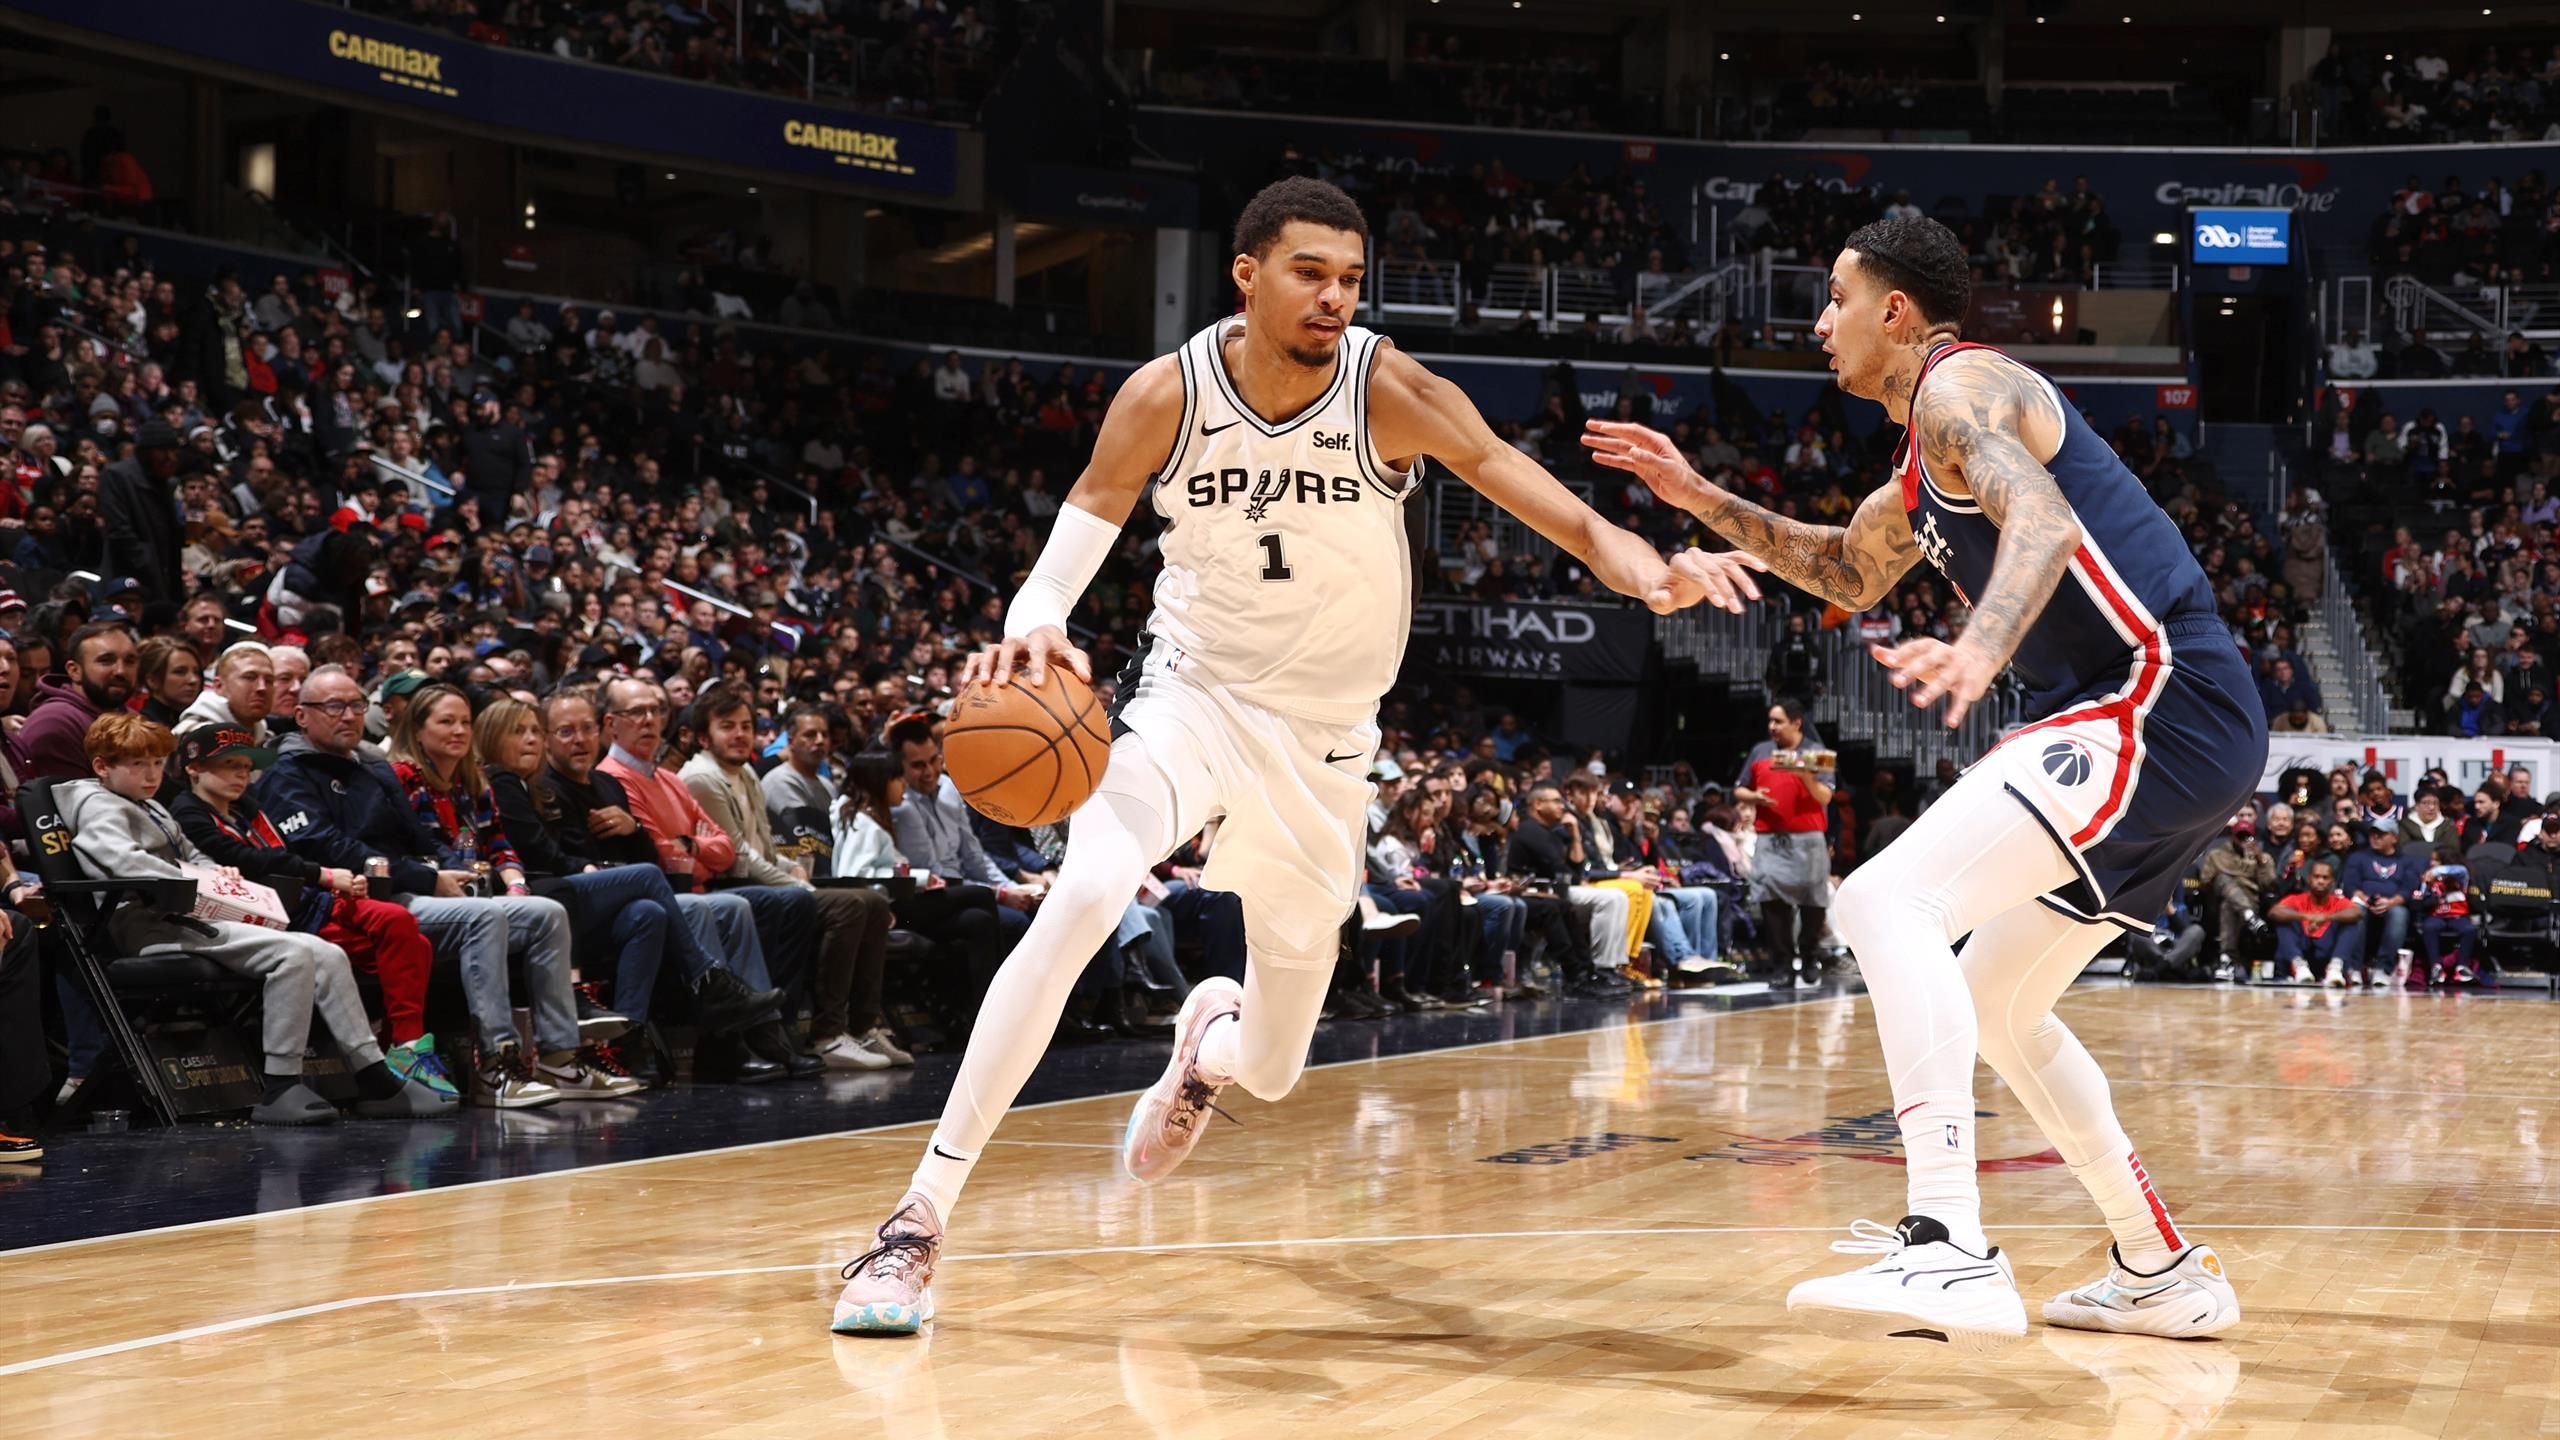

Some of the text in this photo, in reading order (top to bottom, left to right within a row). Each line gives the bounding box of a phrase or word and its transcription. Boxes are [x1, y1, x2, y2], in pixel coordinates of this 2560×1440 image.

[2164, 390, 2191, 405] 107
[1312, 430, 1352, 451] Self.
[1187, 468, 1361, 523] SPURS
[1256, 531, 1294, 582] 1
[1412, 602, 1596, 643] ETIHAD
[1436, 645, 1562, 673] AIRWAYS
